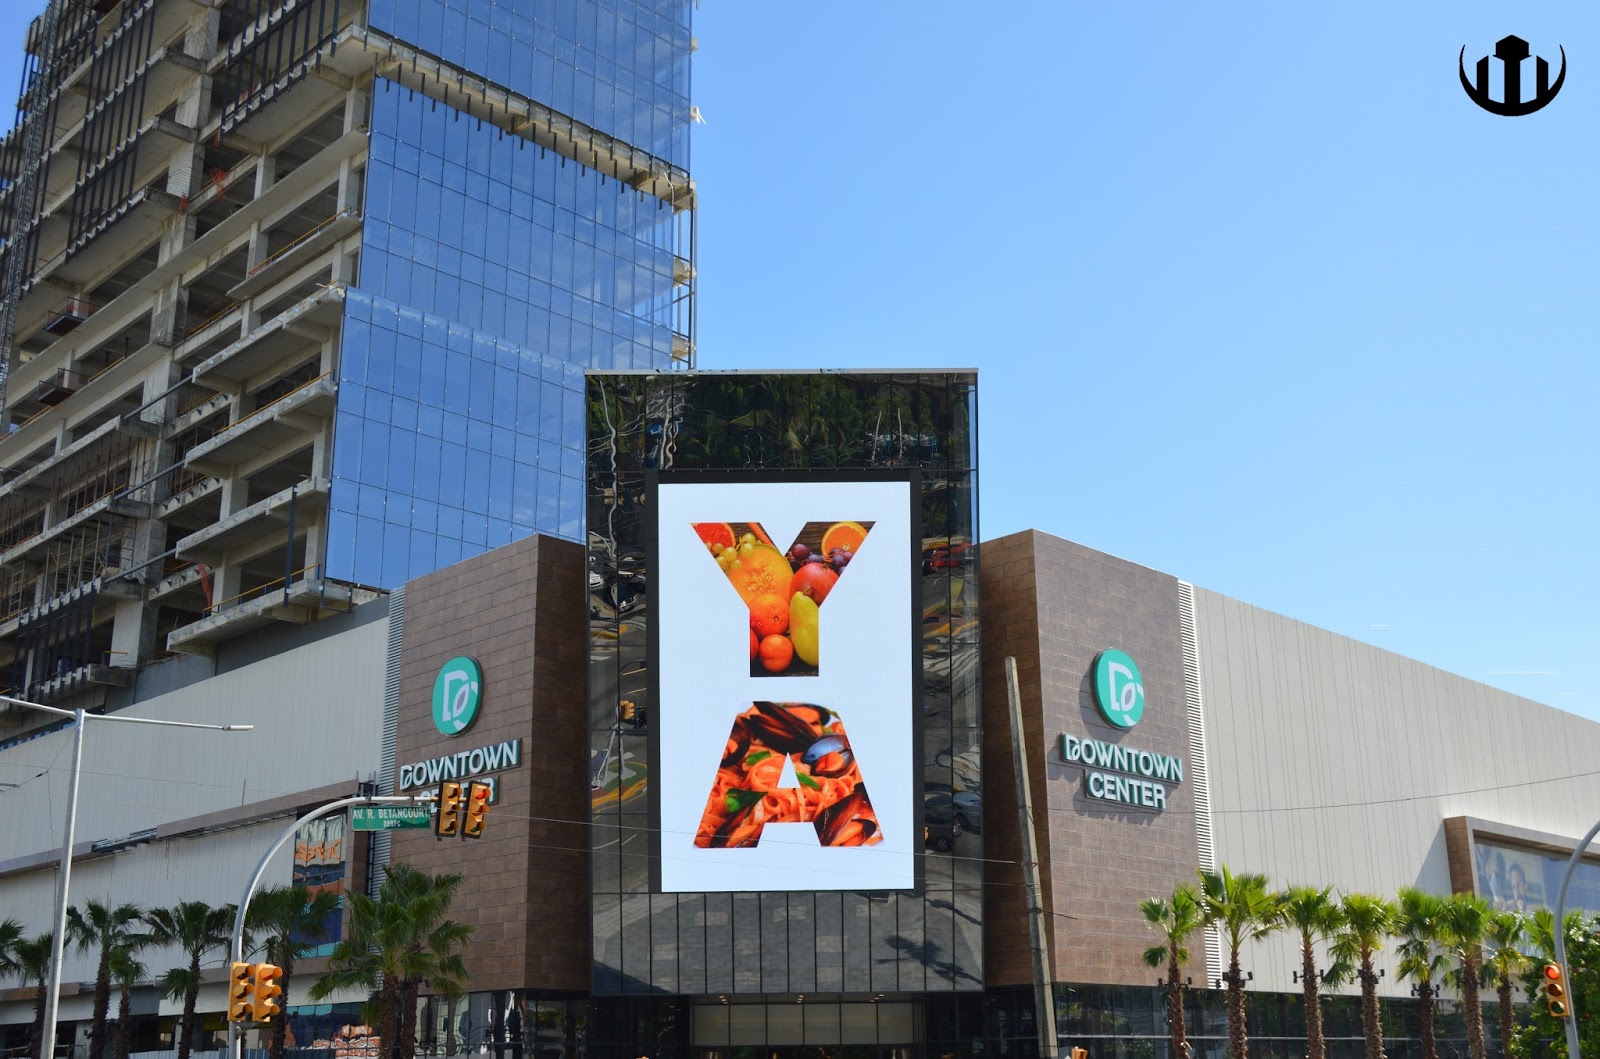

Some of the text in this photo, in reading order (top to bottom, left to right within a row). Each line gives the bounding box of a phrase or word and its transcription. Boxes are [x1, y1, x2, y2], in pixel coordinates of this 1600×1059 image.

[400, 739, 519, 791] DOWNTOWN
[1063, 733, 1183, 782] DOWNTOWN
[1088, 771, 1166, 809] CENTER
[352, 807, 429, 820] AV. R. BETANCOURT
